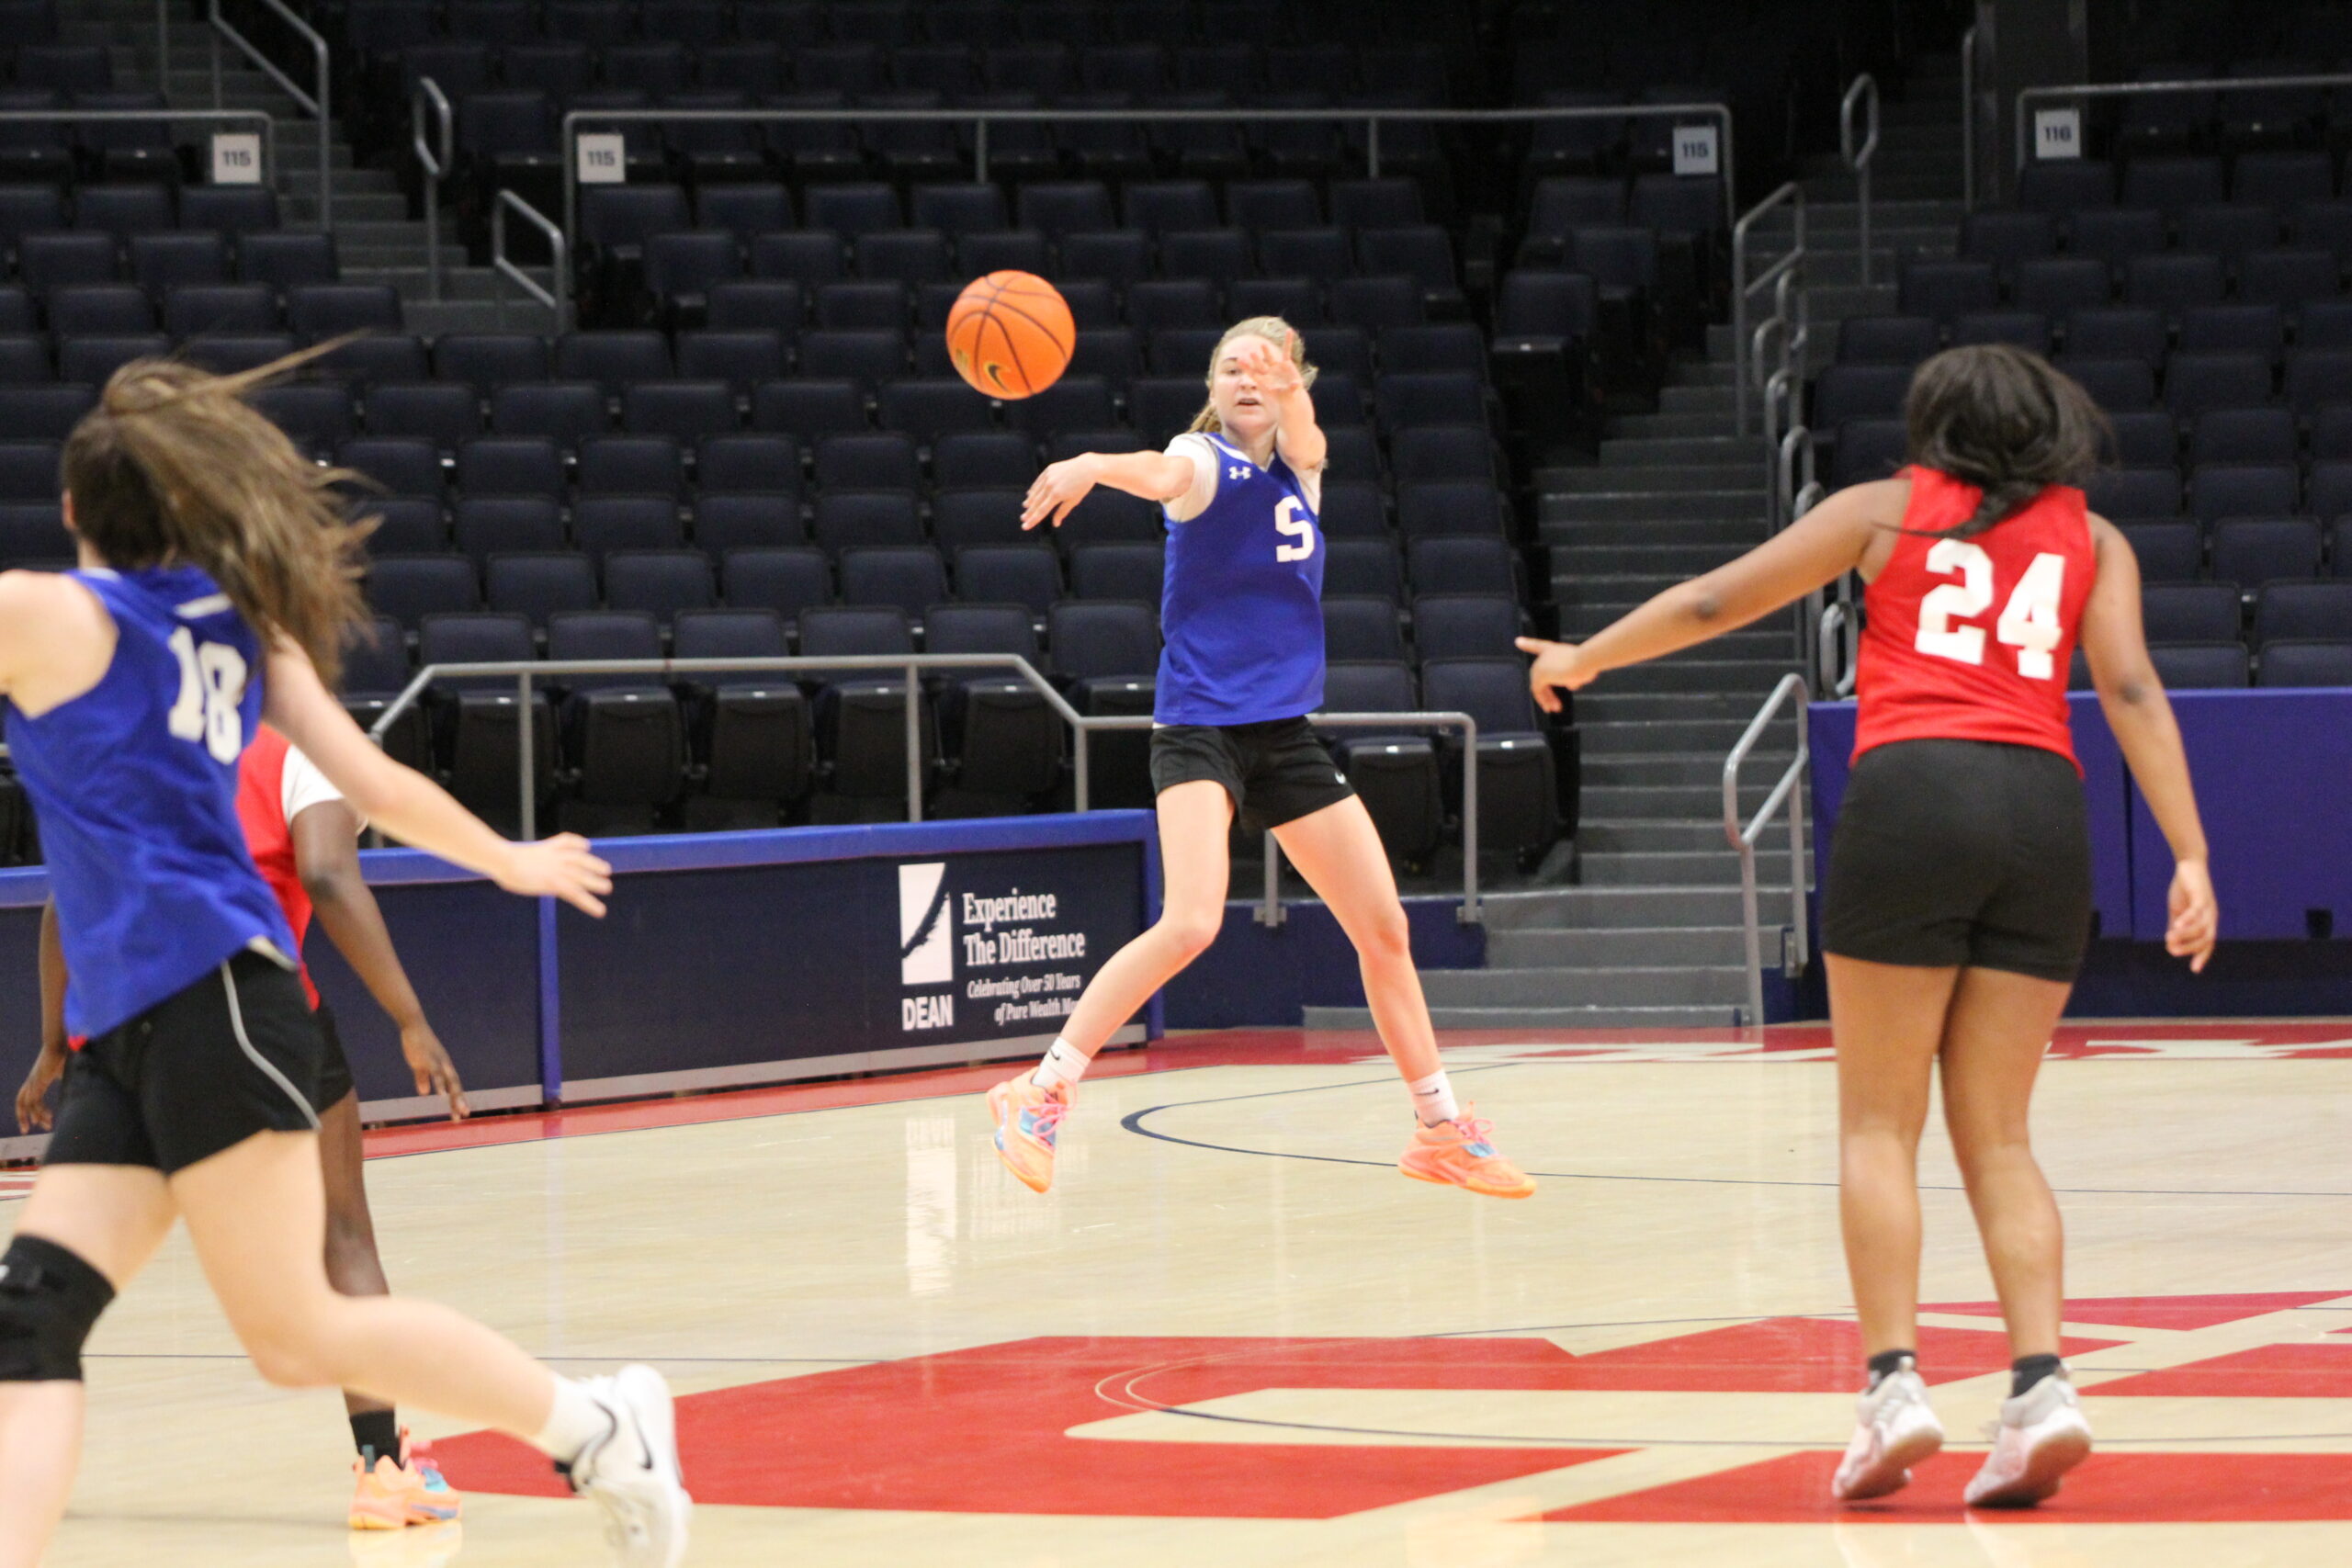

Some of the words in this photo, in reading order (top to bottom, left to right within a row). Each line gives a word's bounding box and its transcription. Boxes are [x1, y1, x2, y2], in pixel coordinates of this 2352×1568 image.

[2045, 125, 2073, 142] 116
[222, 150, 252, 167] 115
[587, 150, 616, 167] 115
[1682, 141, 1709, 159] 115
[1915, 537, 2065, 681] 24
[167, 625, 246, 765] 18
[963, 886, 1057, 932] Experience
[964, 932, 996, 966] The
[999, 928, 1085, 964] Difference
[967, 976, 1020, 999] Celebrating
[1020, 976, 1043, 994] Over
[1043, 973, 1055, 992] 50
[1055, 972, 1081, 990] Years
[901, 995, 954, 1031] DEAN
[994, 1002, 1006, 1026] of
[1006, 1002, 1029, 1021] Pure
[1029, 998, 1061, 1019] Wealth
